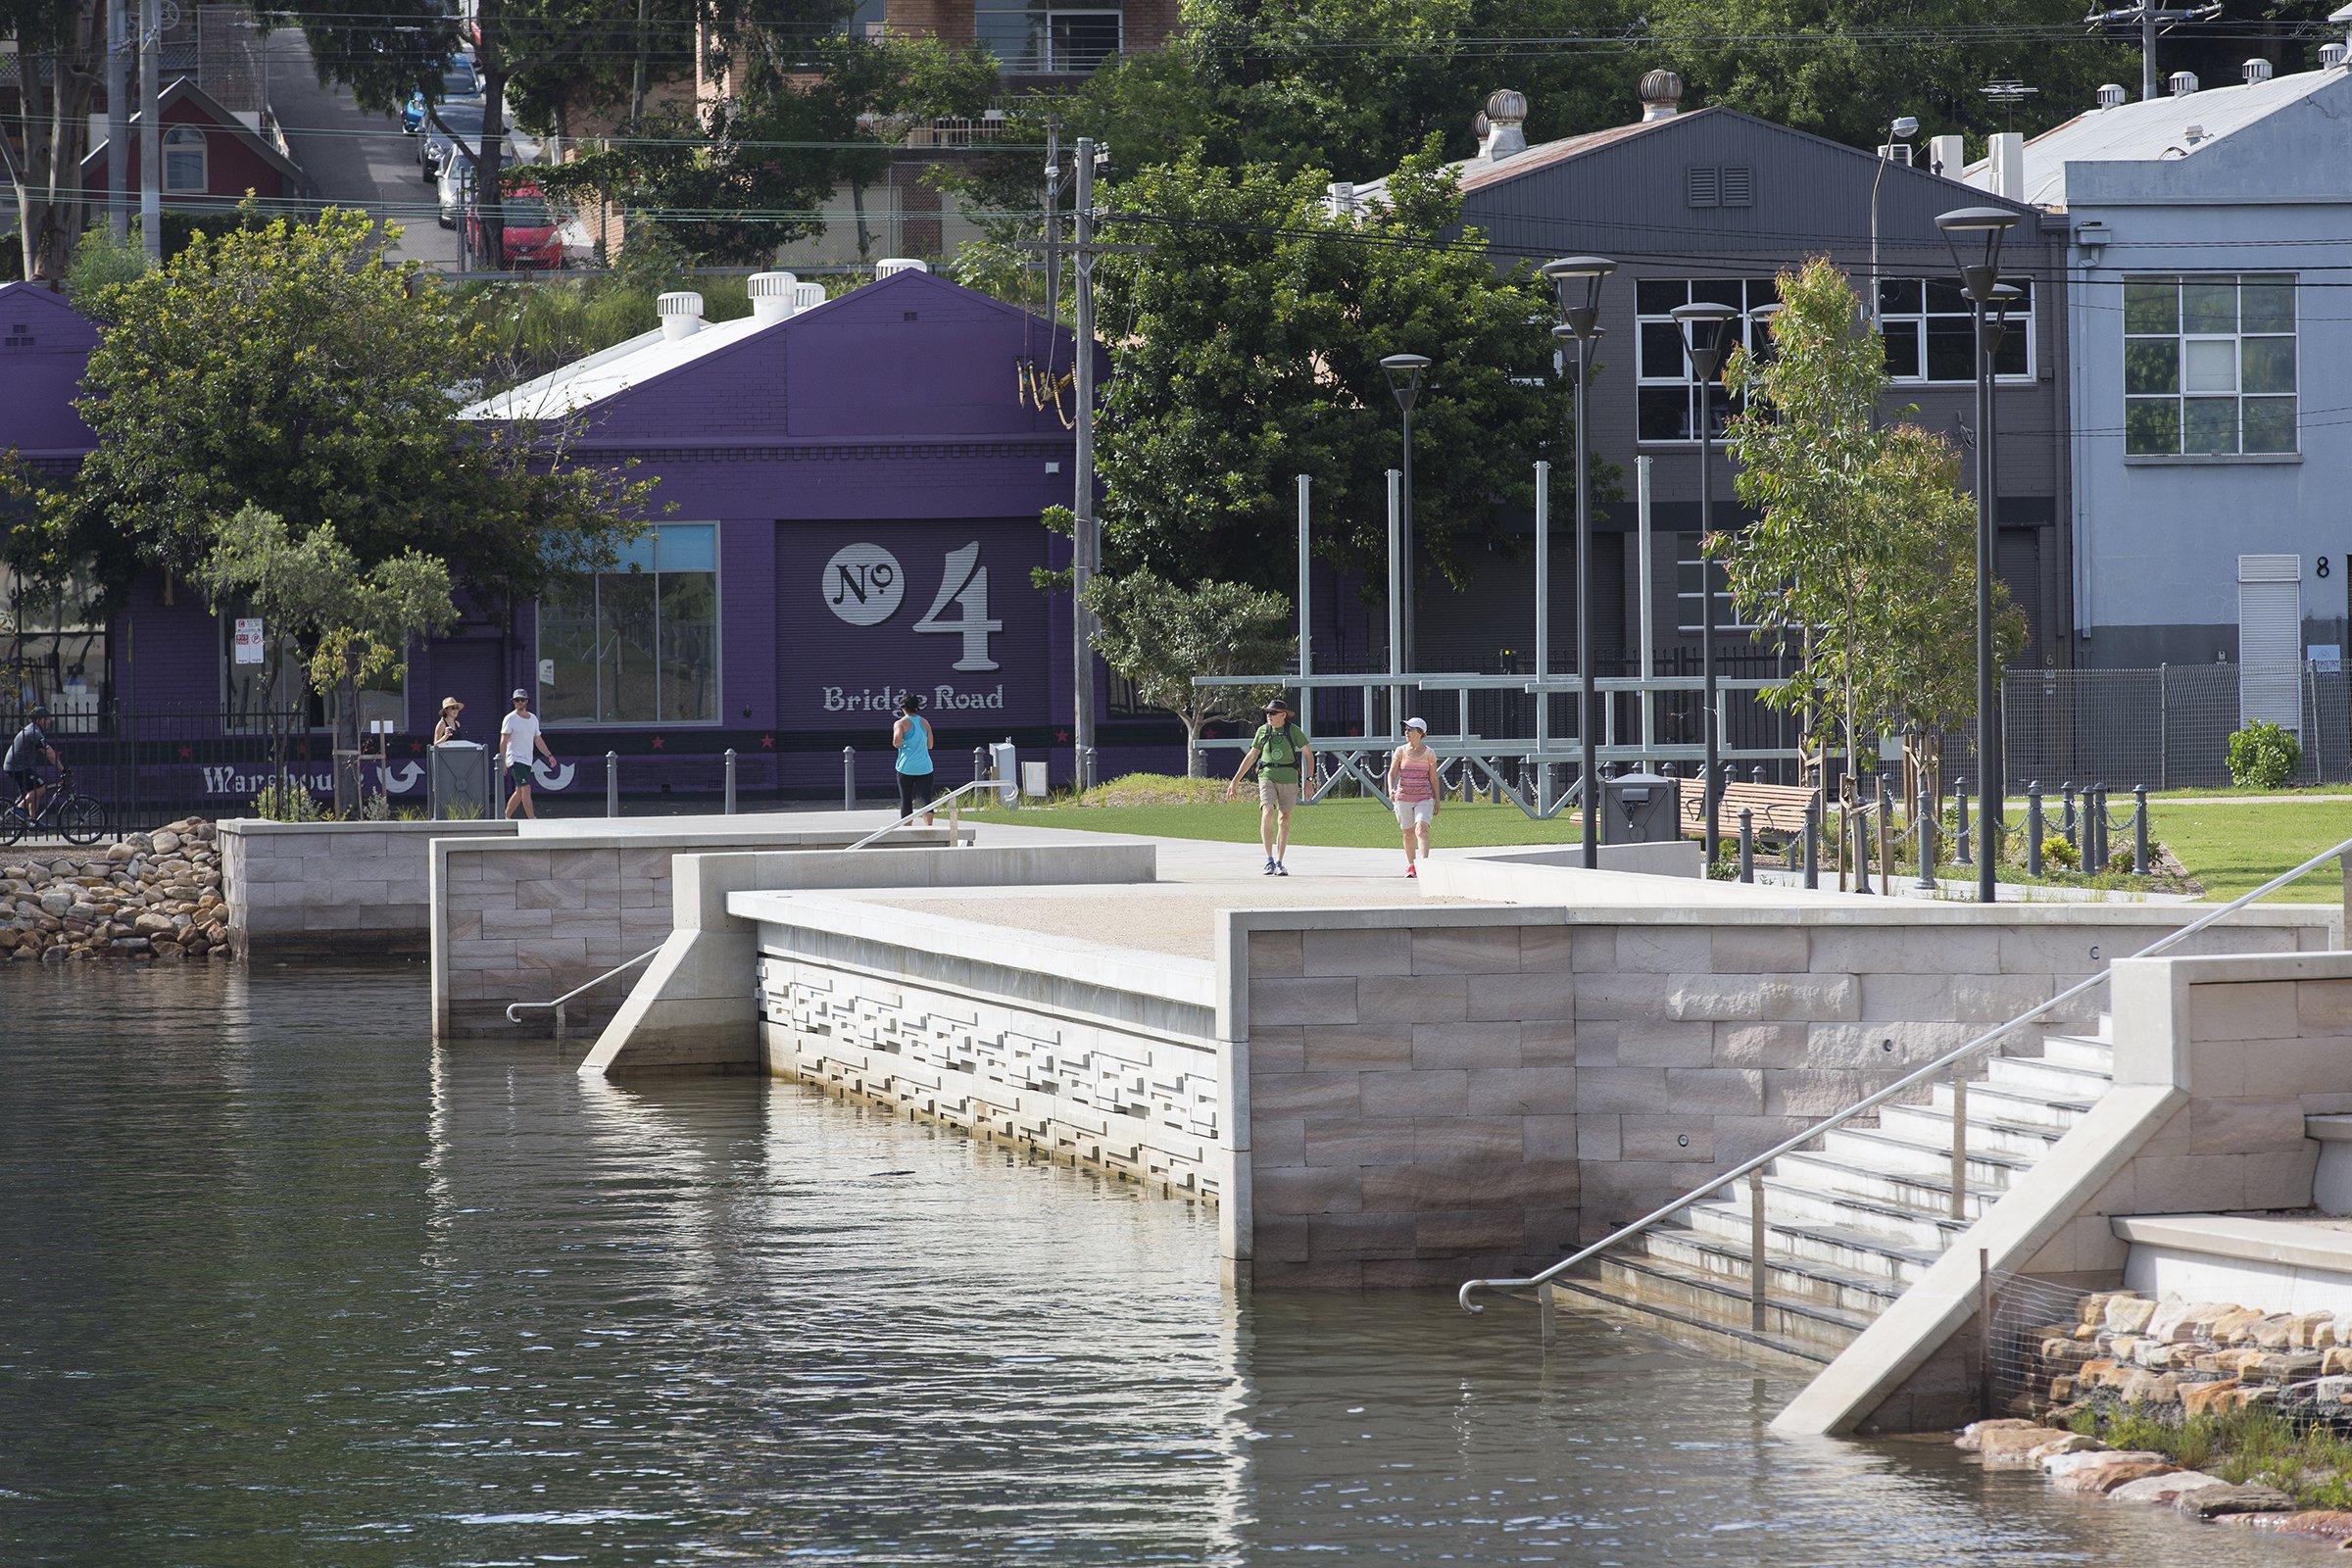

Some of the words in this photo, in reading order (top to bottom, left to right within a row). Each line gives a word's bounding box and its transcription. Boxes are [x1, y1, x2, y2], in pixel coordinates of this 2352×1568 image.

[2317, 556, 2329, 578] 8
[912, 540, 1003, 671] 4
[2046, 654, 2054, 665] 6
[934, 684, 1004, 710] Road
[203, 765, 364, 793] Warehou
